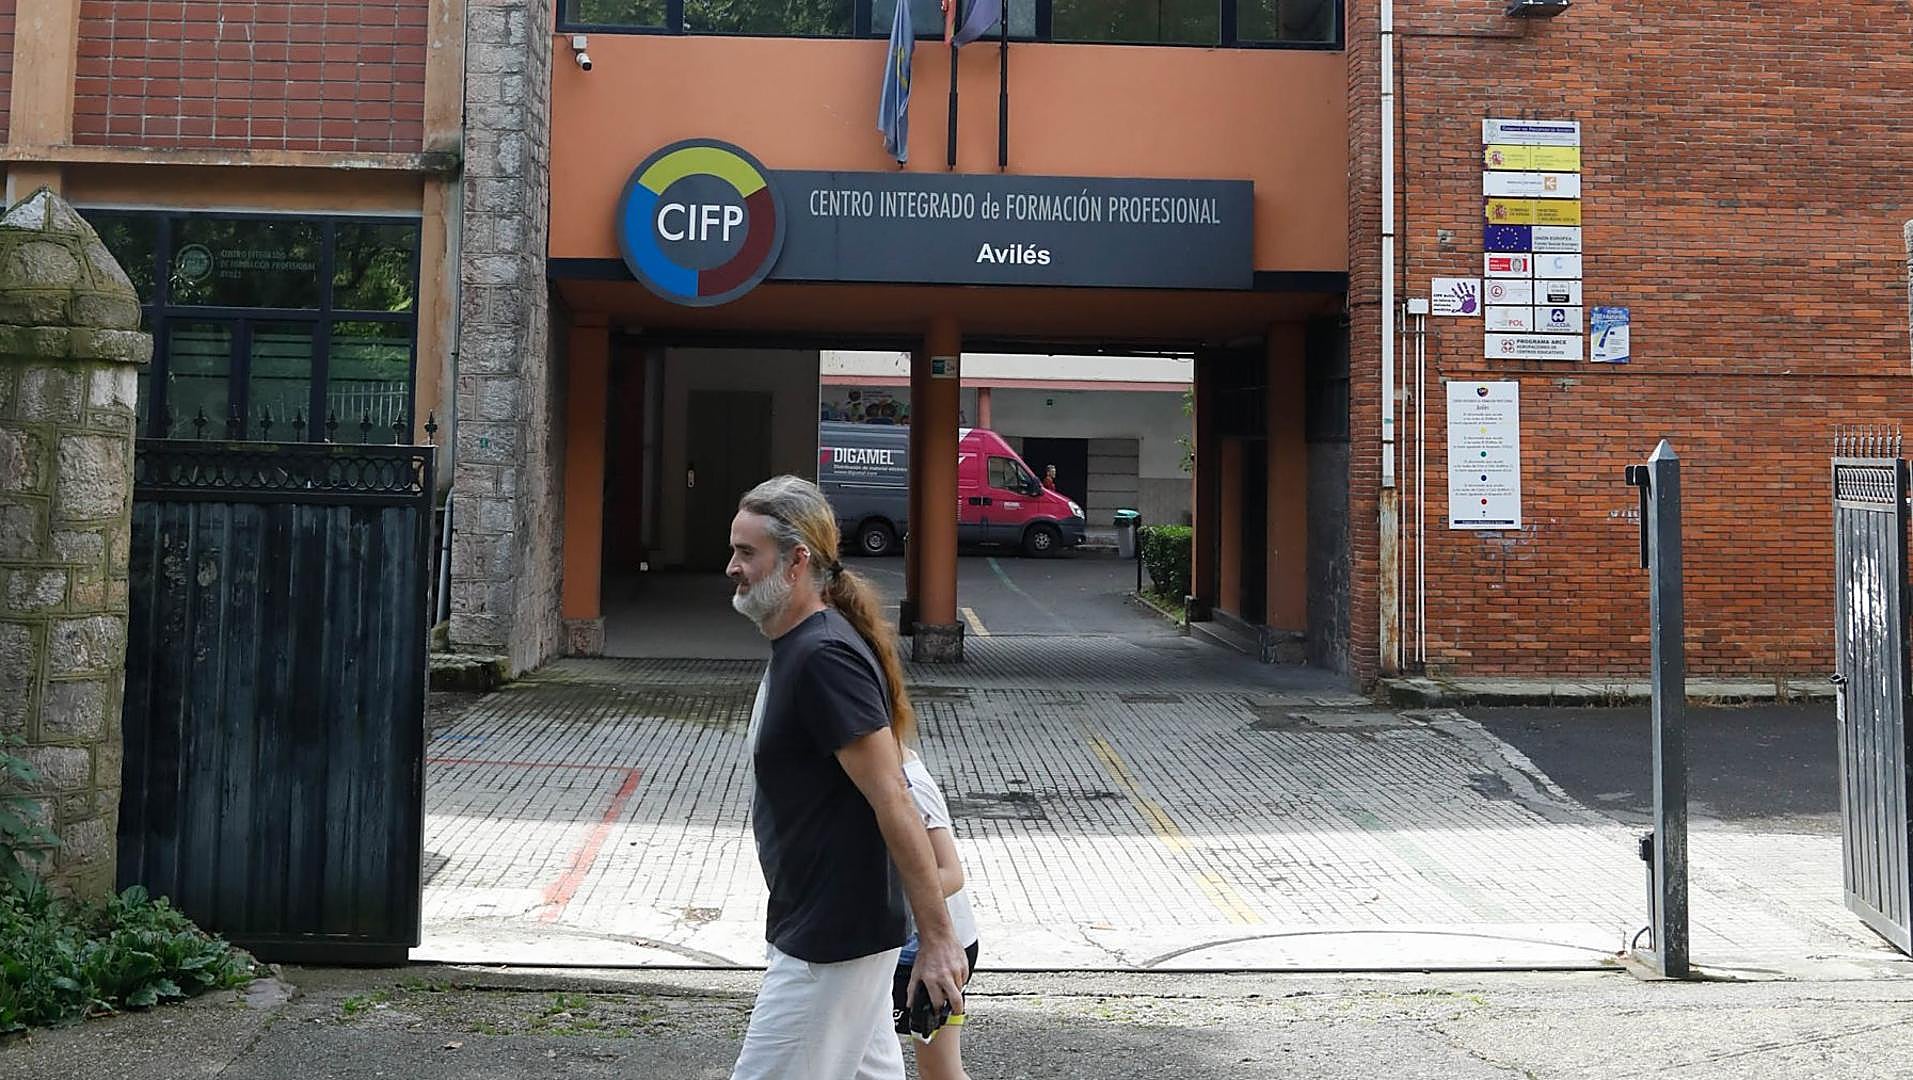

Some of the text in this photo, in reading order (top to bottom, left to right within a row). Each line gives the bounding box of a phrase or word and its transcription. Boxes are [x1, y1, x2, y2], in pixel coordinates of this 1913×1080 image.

[810, 188, 1220, 225] CENTRO INTEGRADO de FORMACIÓN PROFESIONAL
[657, 202, 744, 242] CIFP
[976, 243, 1051, 265] Avilés
[834, 447, 894, 465] DIGAMEL
